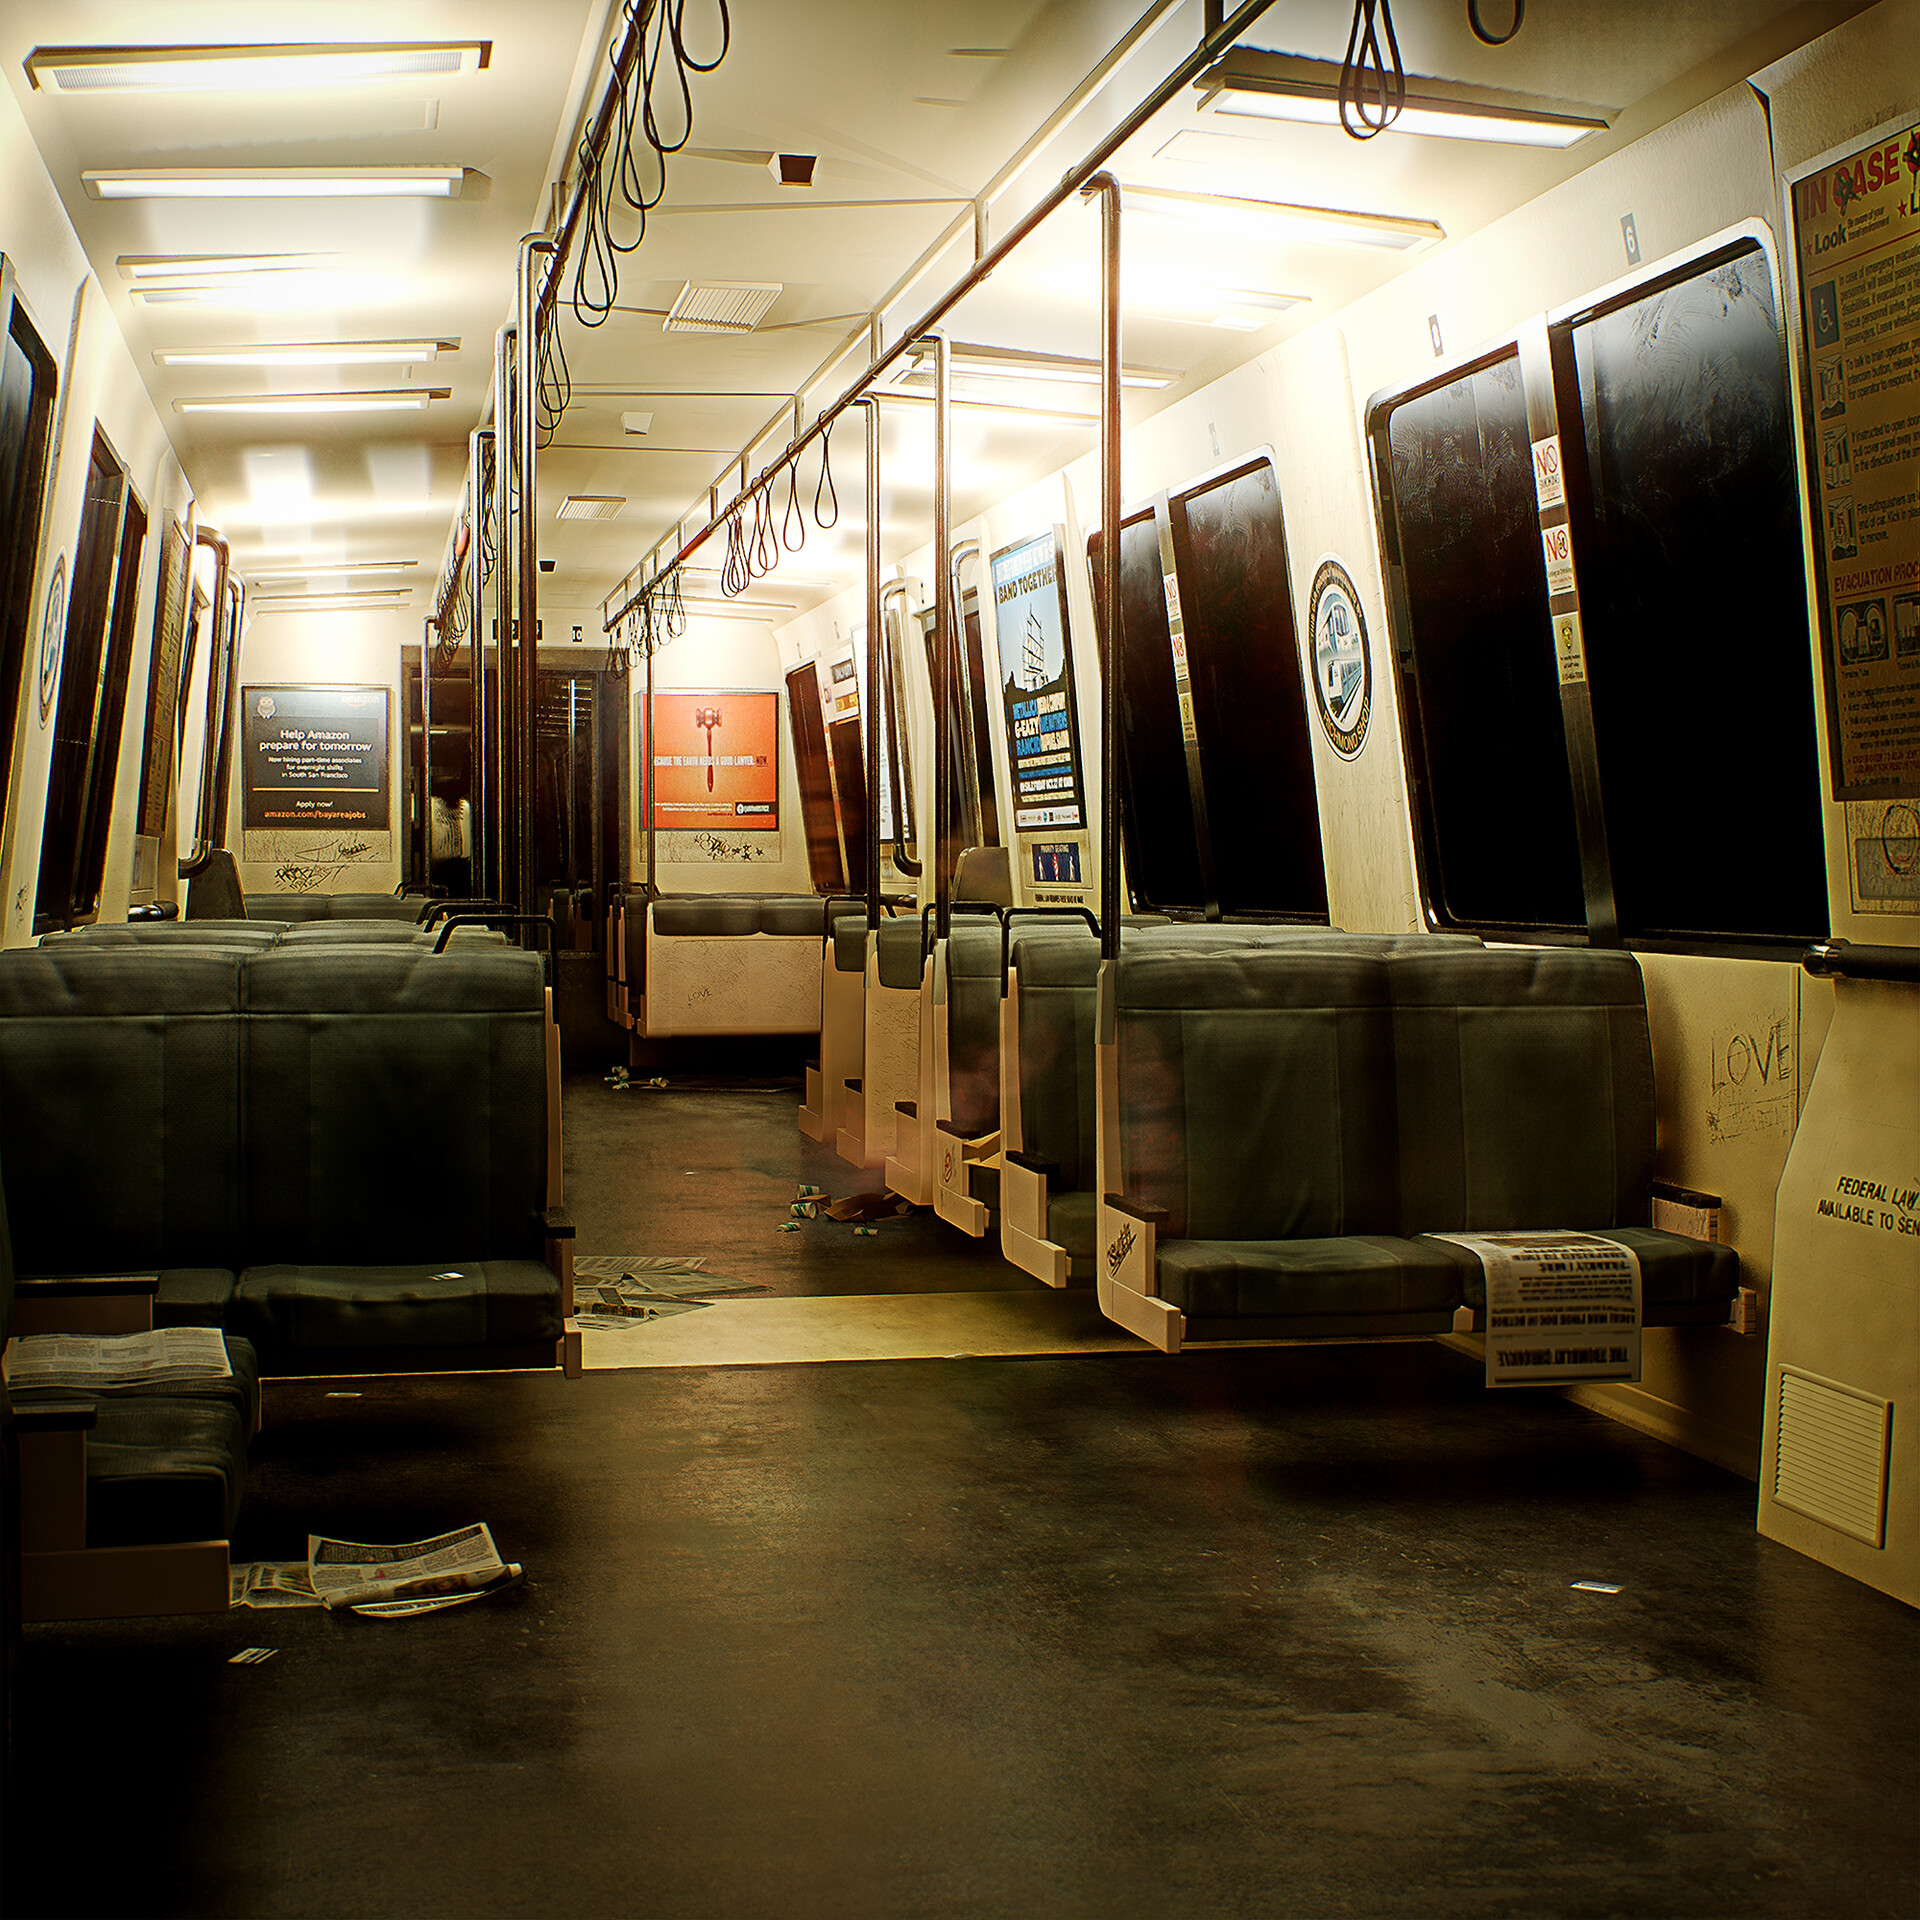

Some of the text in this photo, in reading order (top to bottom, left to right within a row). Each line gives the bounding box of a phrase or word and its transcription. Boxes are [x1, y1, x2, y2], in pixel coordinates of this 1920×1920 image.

[1802, 175, 1828, 222] IN
[1832, 142, 1901, 208] CASE
[1624, 225, 1636, 254] 6
[1815, 223, 1848, 255] Look
[1536, 444, 1558, 479] NO
[1834, 559, 1920, 593] EVACUATION PROC
[998, 581, 1018, 605] BAND
[572, 629, 583, 640] 10
[280, 730, 350, 741] Help Amazon
[1014, 716, 1040, 740] G-EAZY
[1322, 696, 1371, 752] RICHMOND SHOP
[259, 741, 373, 752] prepare for tomorrow
[1016, 736, 1041, 757] RANCID
[654, 756, 673, 766] ECAUSE
[673, 756, 682, 766] THE
[683, 756, 699, 766] EARTH
[720, 756, 734, 766] GOOD
[264, 809, 367, 819] amazon.com/bayareajobs
[687, 986, 713, 1004] LOVE
[1710, 1019, 1791, 1096] LOVE
[1837, 1176, 1919, 1210] FEDERAL LAW
[1817, 1198, 1920, 1237] AVAILABLE TO SEN
